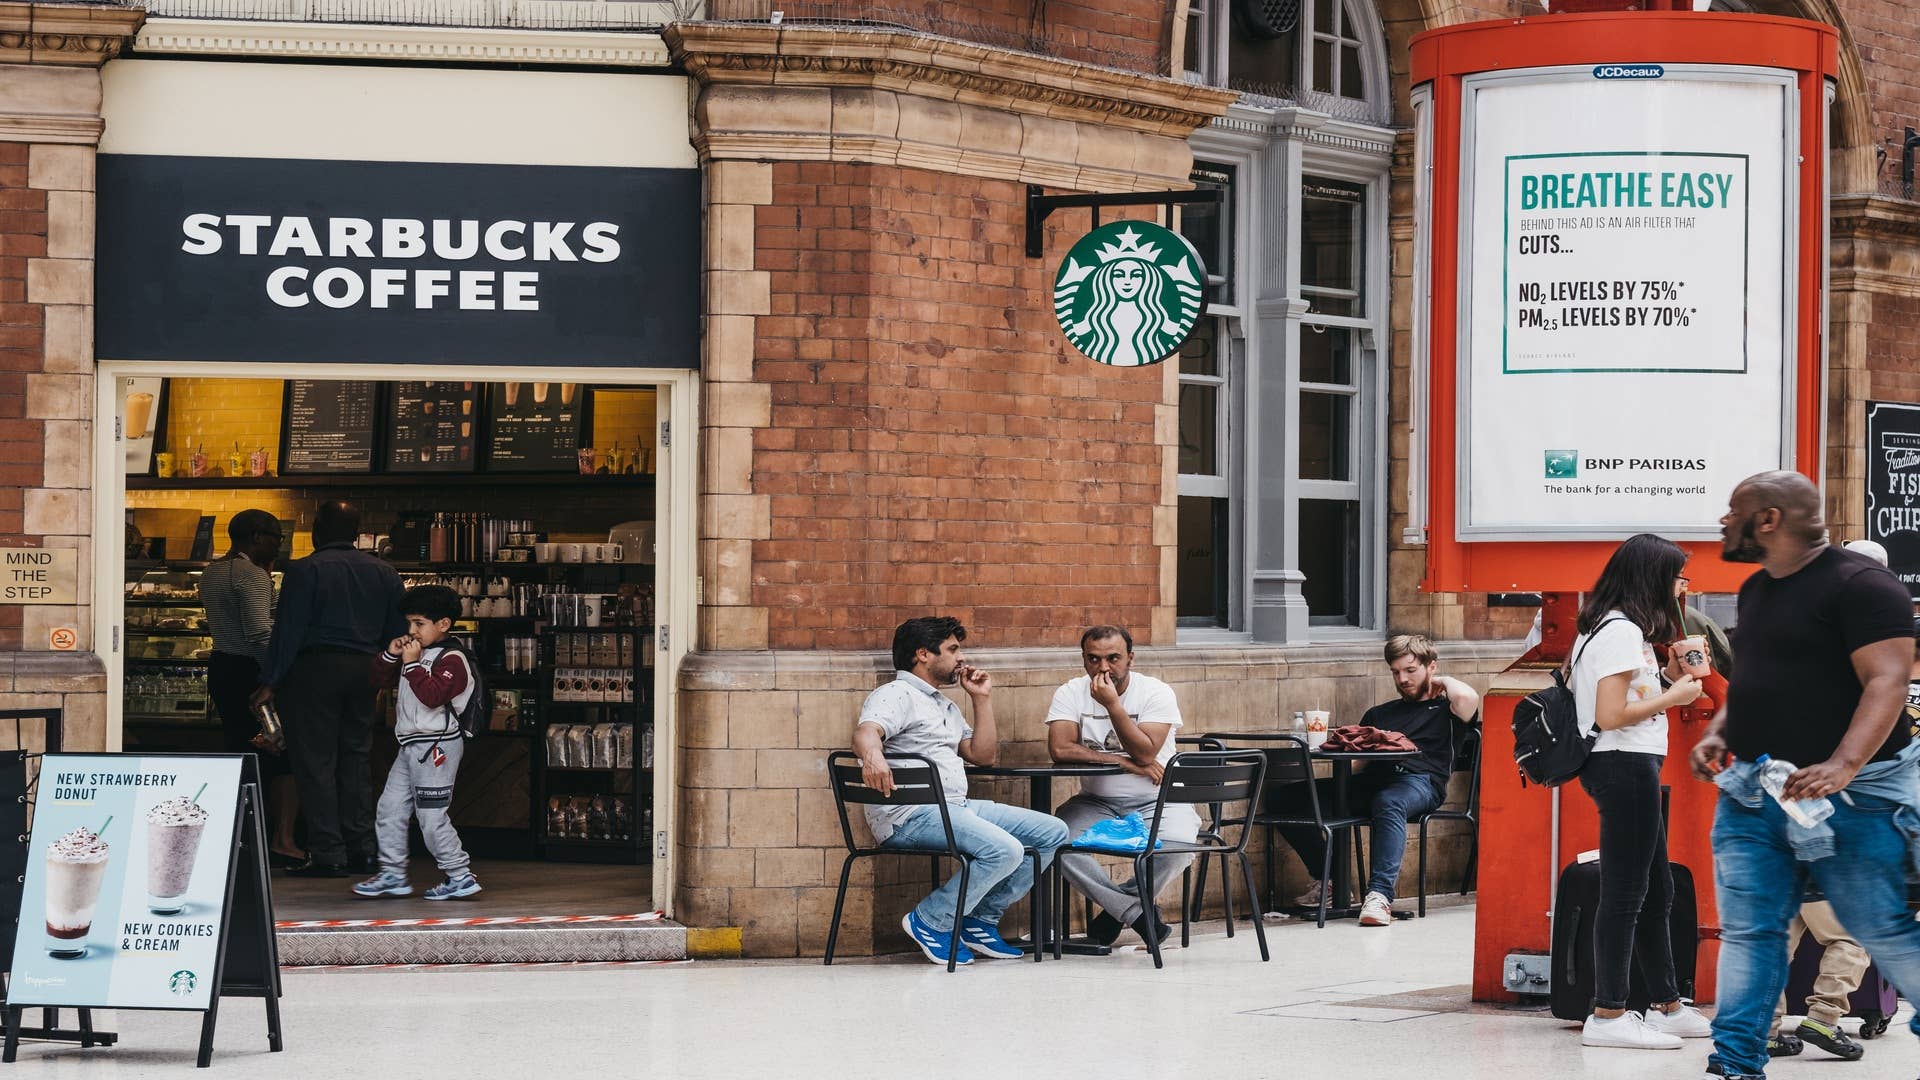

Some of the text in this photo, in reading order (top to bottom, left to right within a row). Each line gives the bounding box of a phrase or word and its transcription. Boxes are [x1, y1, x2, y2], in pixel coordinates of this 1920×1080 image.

[1597, 67, 1660, 77] JCDecaux
[1521, 172, 1733, 210] BREATHE EASY
[1520, 216, 1696, 231] BEHIND THIS AD IS AN AIR FILTER THAT
[181, 213, 621, 263] STARBUCKS
[1519, 234, 1574, 255] CUTS...
[266, 266, 540, 310] COFFEE
[1550, 281, 1608, 301] LEVELS
[1613, 281, 1636, 300] BY
[1562, 307, 1620, 327] LEVELS
[1625, 307, 1648, 326] BY
[1585, 458, 1706, 470] BNP PARIBAS
[1544, 485, 1562, 494] The
[1566, 485, 1592, 494] bank
[1595, 484, 1611, 496] for
[1625, 485, 1673, 496] changing
[1675, 485, 1706, 494] world
[6, 552, 52, 565] MIND
[11, 569, 47, 582] THE
[5, 586, 52, 598] STEP
[57, 773, 177, 786] NEW STRAWBERRY
[55, 788, 97, 800] DONUT
[124, 923, 214, 937] NEW COOKIES
[122, 938, 180, 951] & CREAM
